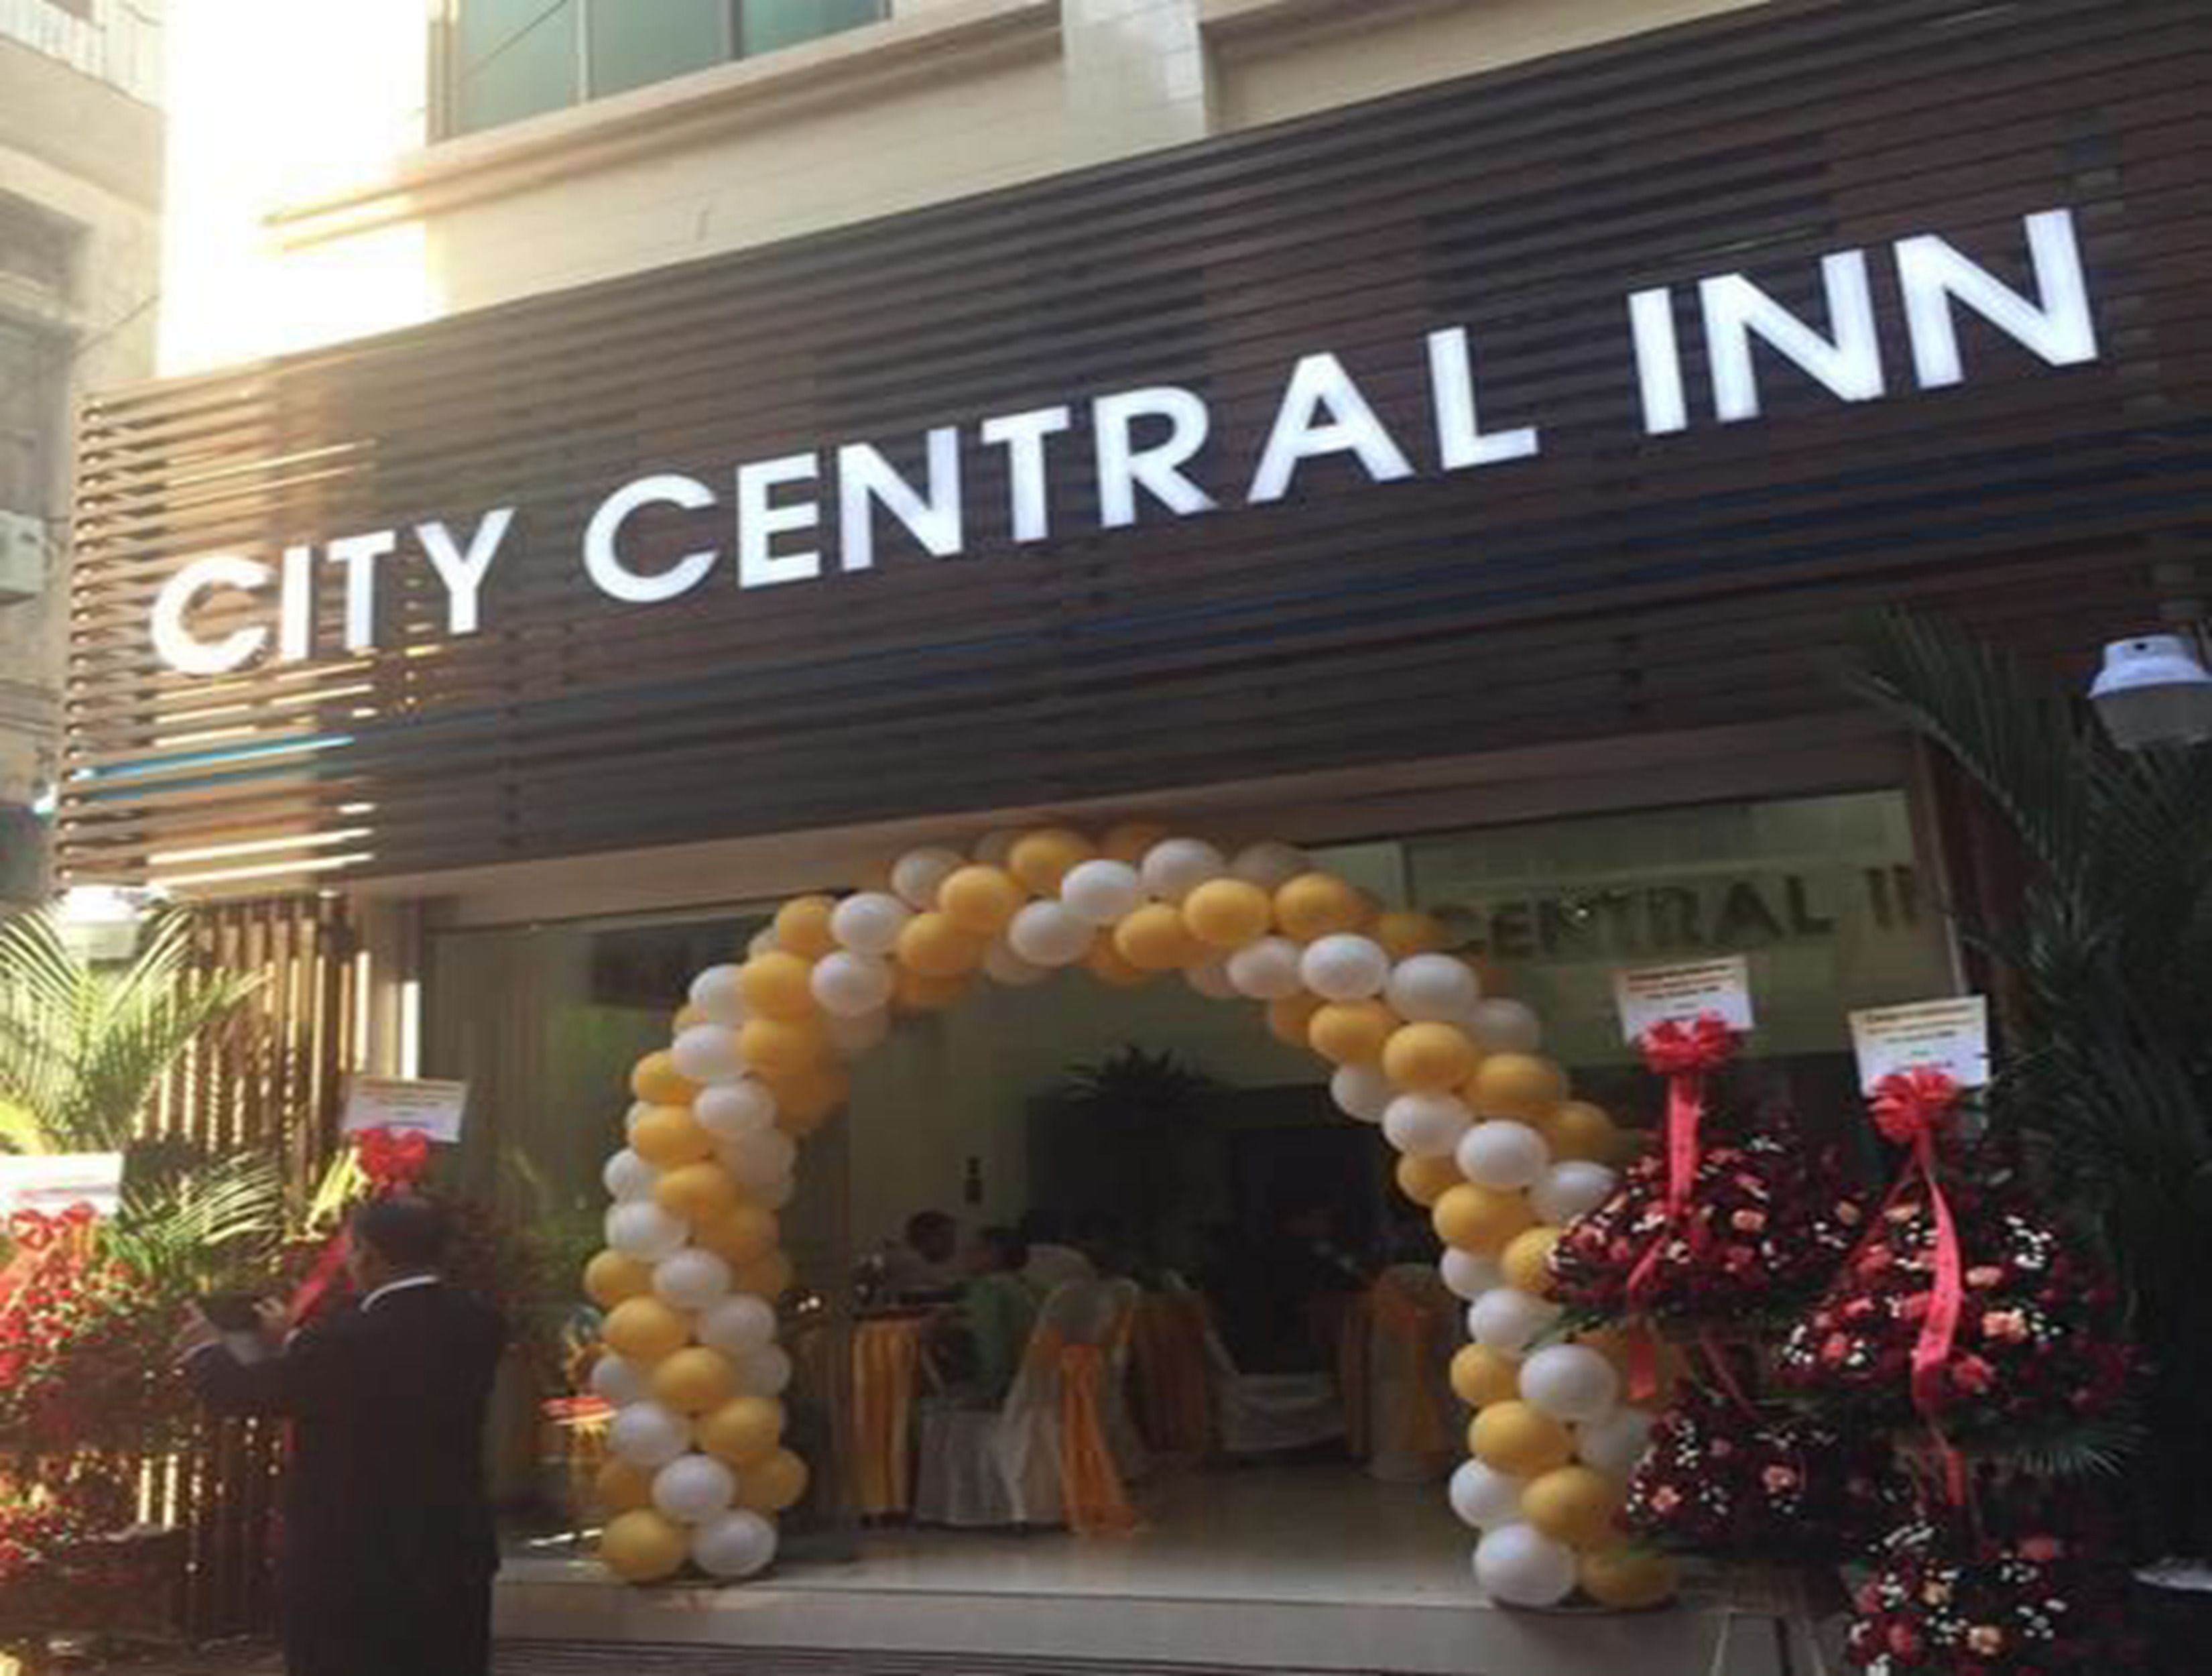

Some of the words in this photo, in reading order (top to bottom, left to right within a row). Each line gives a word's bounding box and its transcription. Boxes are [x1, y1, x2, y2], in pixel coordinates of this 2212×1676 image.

[149, 507, 514, 675] CITY
[583, 327, 1537, 603] CENTRAL
[1629, 210, 2097, 434] INN
